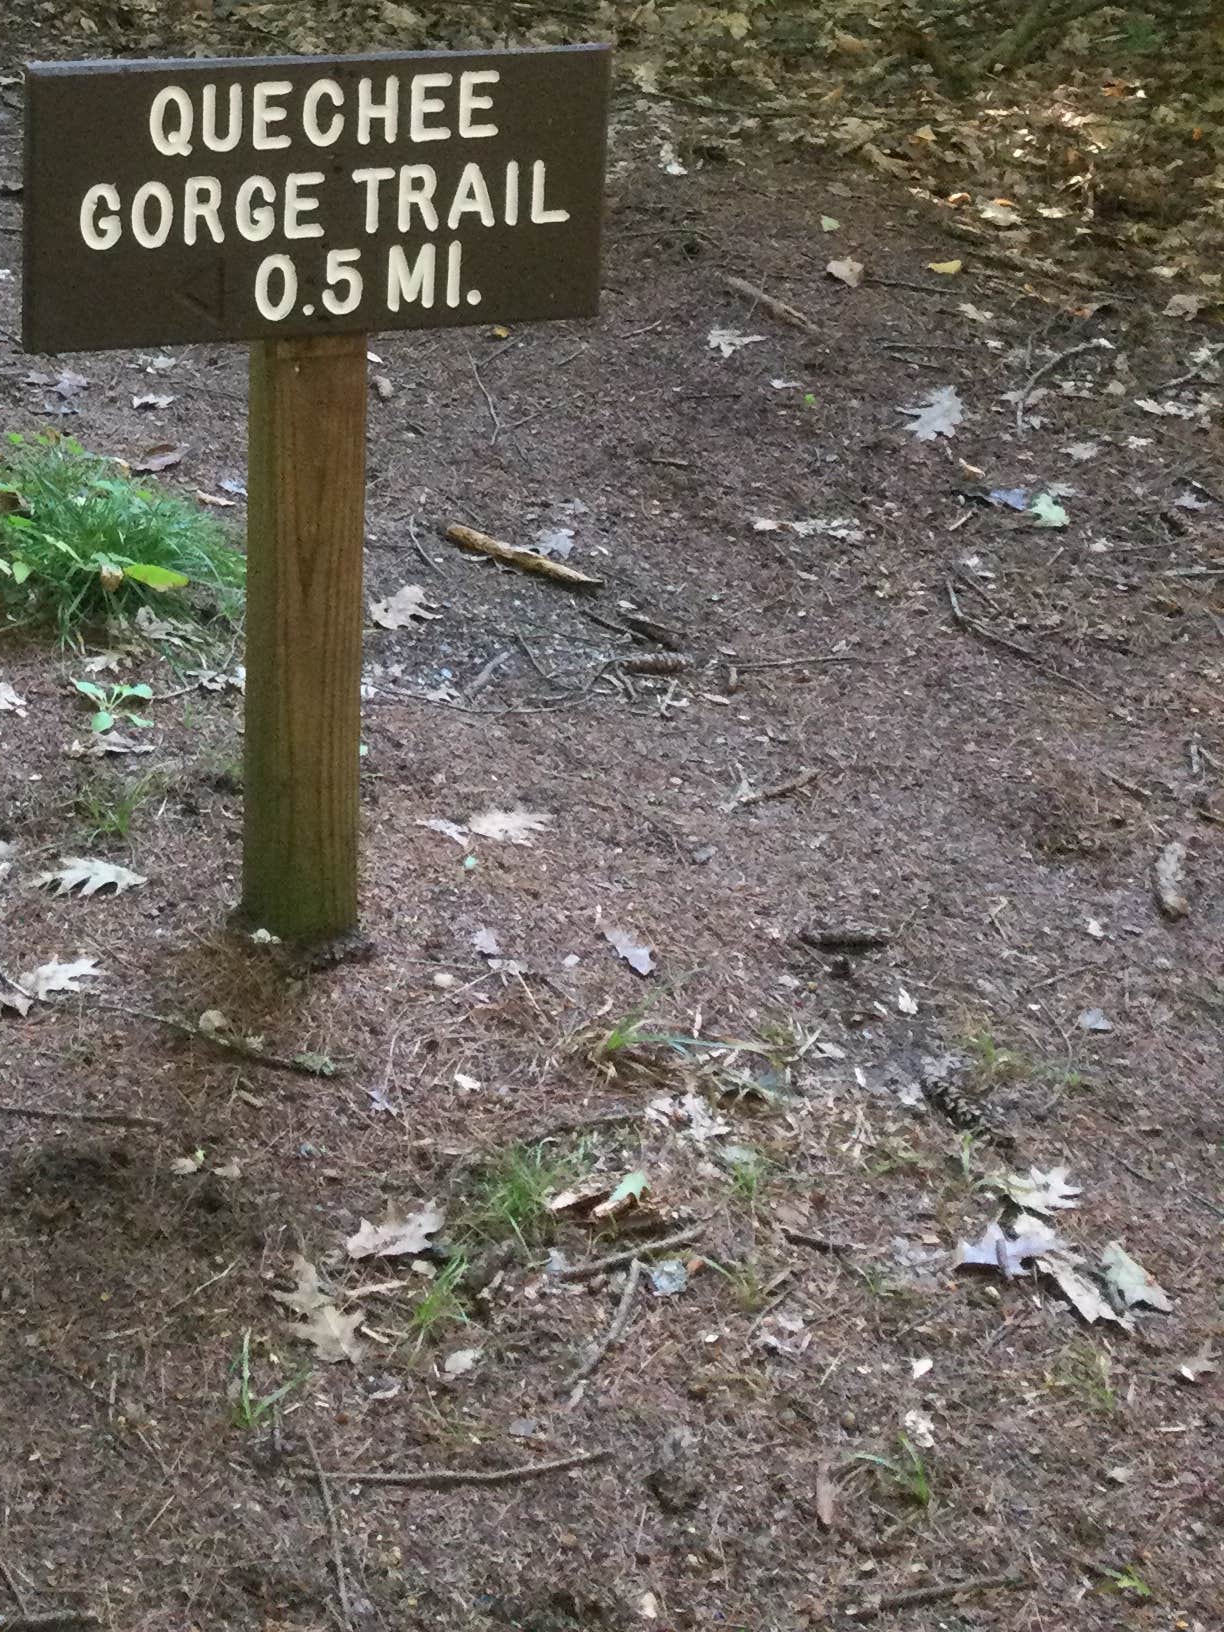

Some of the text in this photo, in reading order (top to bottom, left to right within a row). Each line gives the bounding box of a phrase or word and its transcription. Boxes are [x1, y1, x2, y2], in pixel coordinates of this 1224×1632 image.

[149, 70, 500, 156] QUECHEE
[79, 159, 570, 251] GORGE TRAIL
[254, 240, 482, 322] 0.5 MI.
